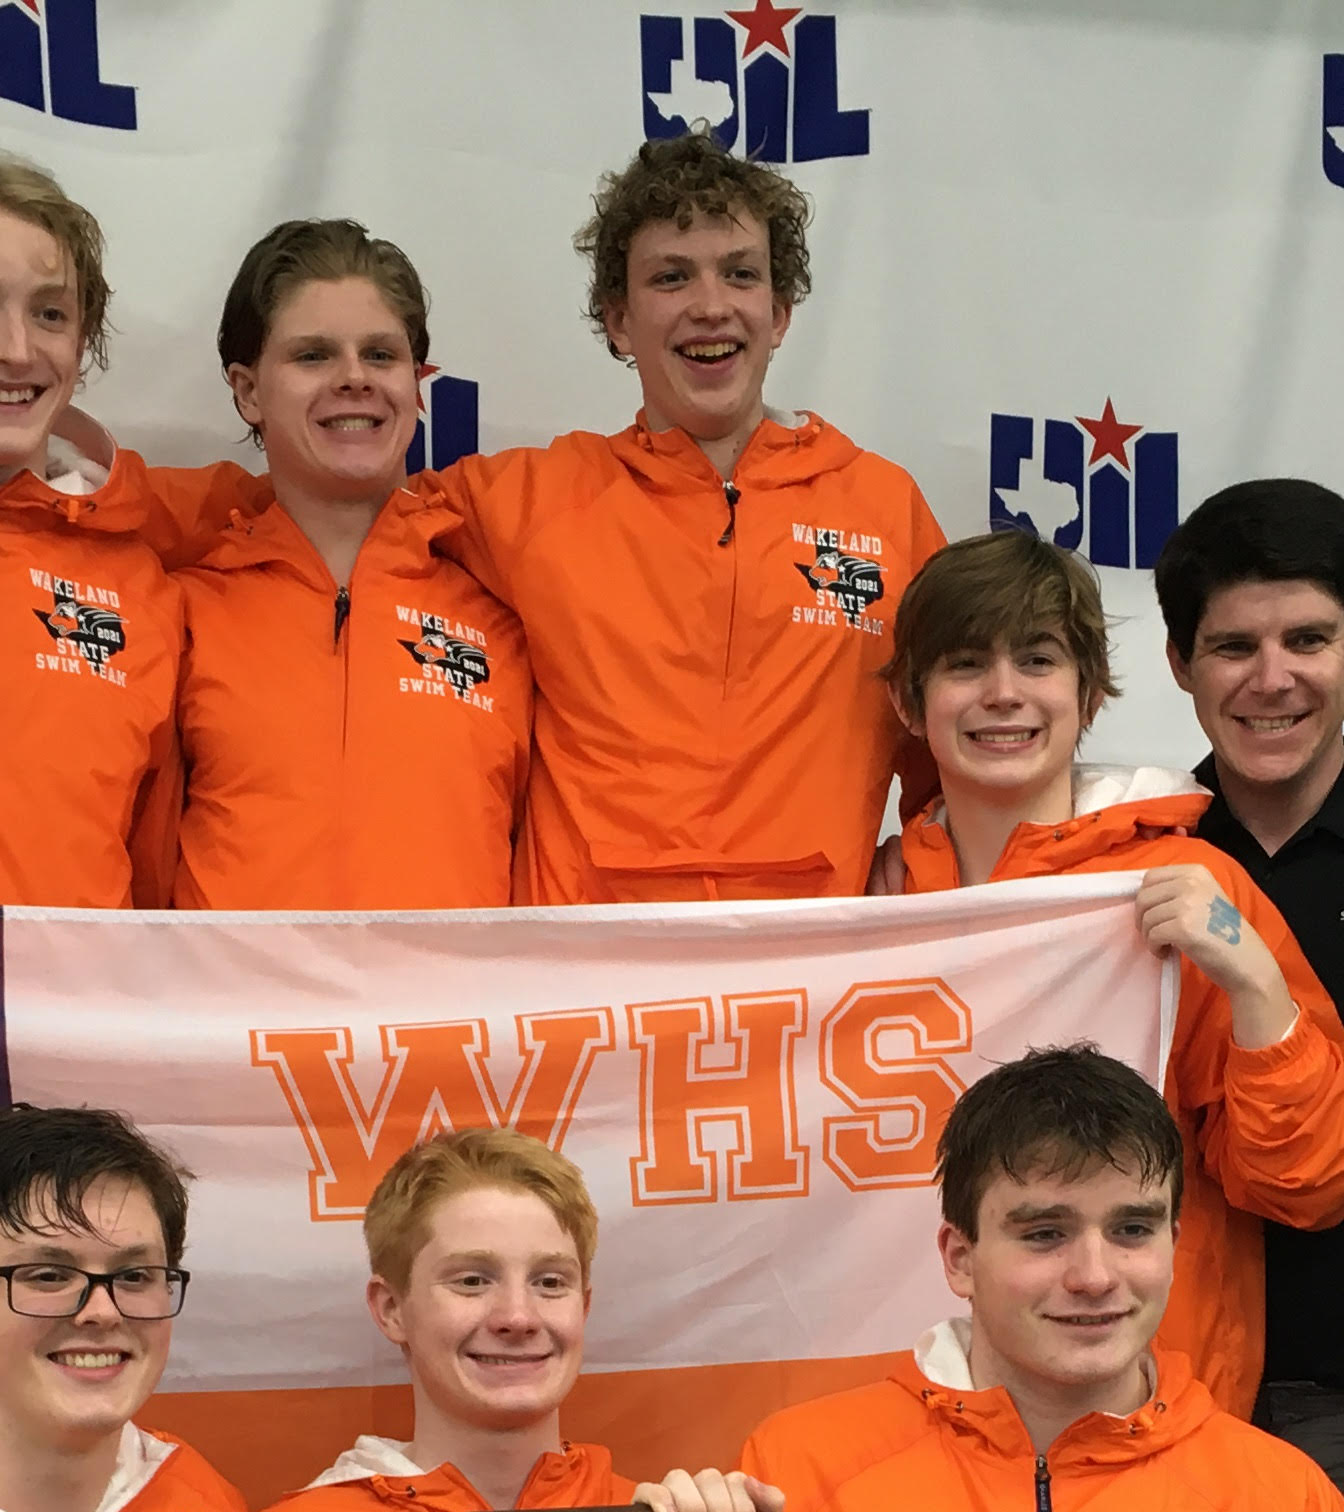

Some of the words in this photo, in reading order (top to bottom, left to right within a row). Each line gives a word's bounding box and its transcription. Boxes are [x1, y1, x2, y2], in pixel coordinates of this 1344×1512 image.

[640, 0, 870, 164] UIL
[792, 522, 883, 556] WAKELAND
[29, 568, 121, 609] WAKELAND
[816, 589, 866, 613] STATE
[855, 578, 879, 593] 2021
[97, 627, 121, 643] 2021
[395, 605, 487, 647] WAKELAND
[792, 606, 837, 626] SWIM
[843, 611, 884, 636] TEAM
[56, 637, 110, 663] STATE
[35, 653, 81, 675] SWIM
[87, 660, 127, 688] TEAM
[422, 663, 475, 690] STATE
[463, 658, 486, 676] 2021
[399, 677, 446, 697] SWIM
[452, 685, 494, 713] TEAM
[250, 976, 974, 1222] WHS
